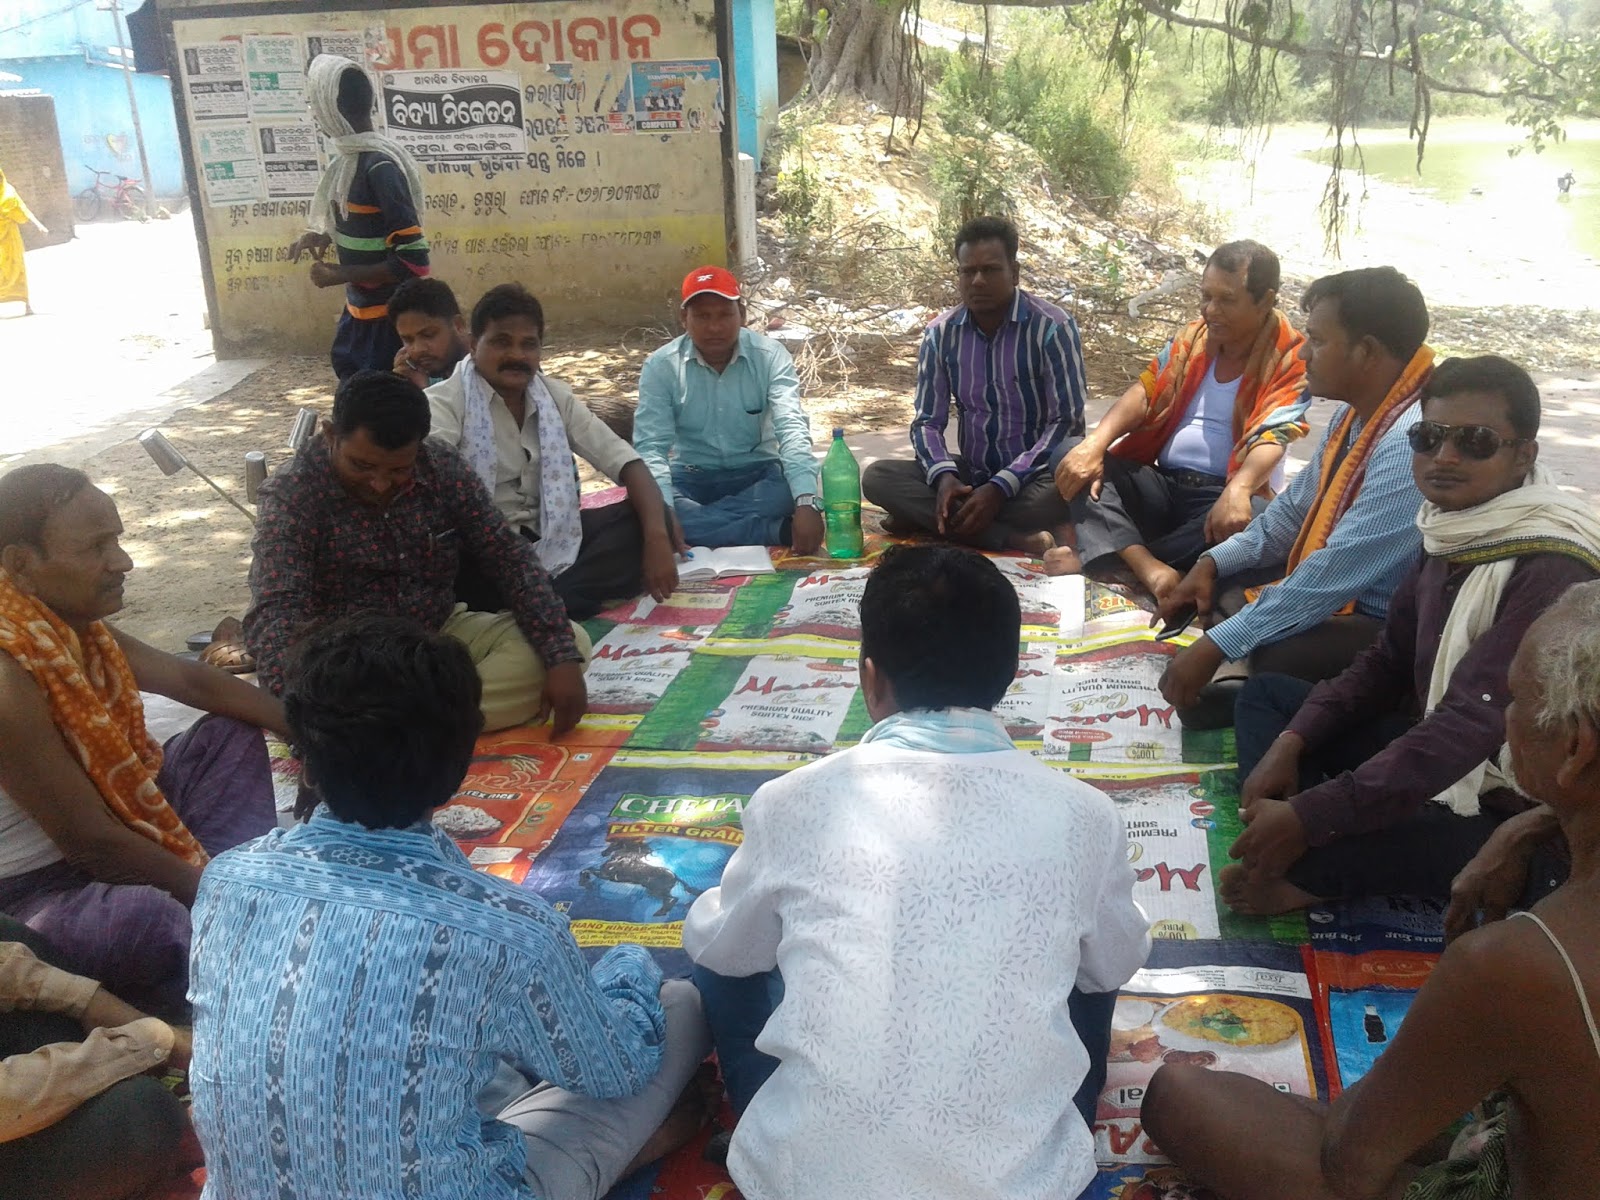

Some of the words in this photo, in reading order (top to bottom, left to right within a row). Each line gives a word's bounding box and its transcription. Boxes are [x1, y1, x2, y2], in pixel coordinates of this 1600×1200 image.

[477, 14, 661, 67] ଦୋକାନ
[392, 94, 438, 126] ବିଦ୍ୟା
[441, 93, 516, 124] ନିକେତନ
[641, 121, 677, 129] COMPUTER
[281, 199, 311, 217] ଦୋକା
[1075, 678, 1098, 687] RICE
[1101, 677, 1141, 685] SORTEX
[1061, 684, 1103, 695] QUALITY
[1106, 683, 1157, 692] PREMIUM
[740, 705, 788, 713] PREMIUM
[791, 707, 833, 717] QUALITY
[1132, 749, 1156, 760] 100%
[488, 792, 515, 800] RICE
[620, 797, 742, 815] CHETA
[609, 824, 680, 834] FILTER
[1125, 820, 1158, 828] SORT
[1128, 828, 1178, 839] PREMIU
[1162, 923, 1185, 932] PURE
